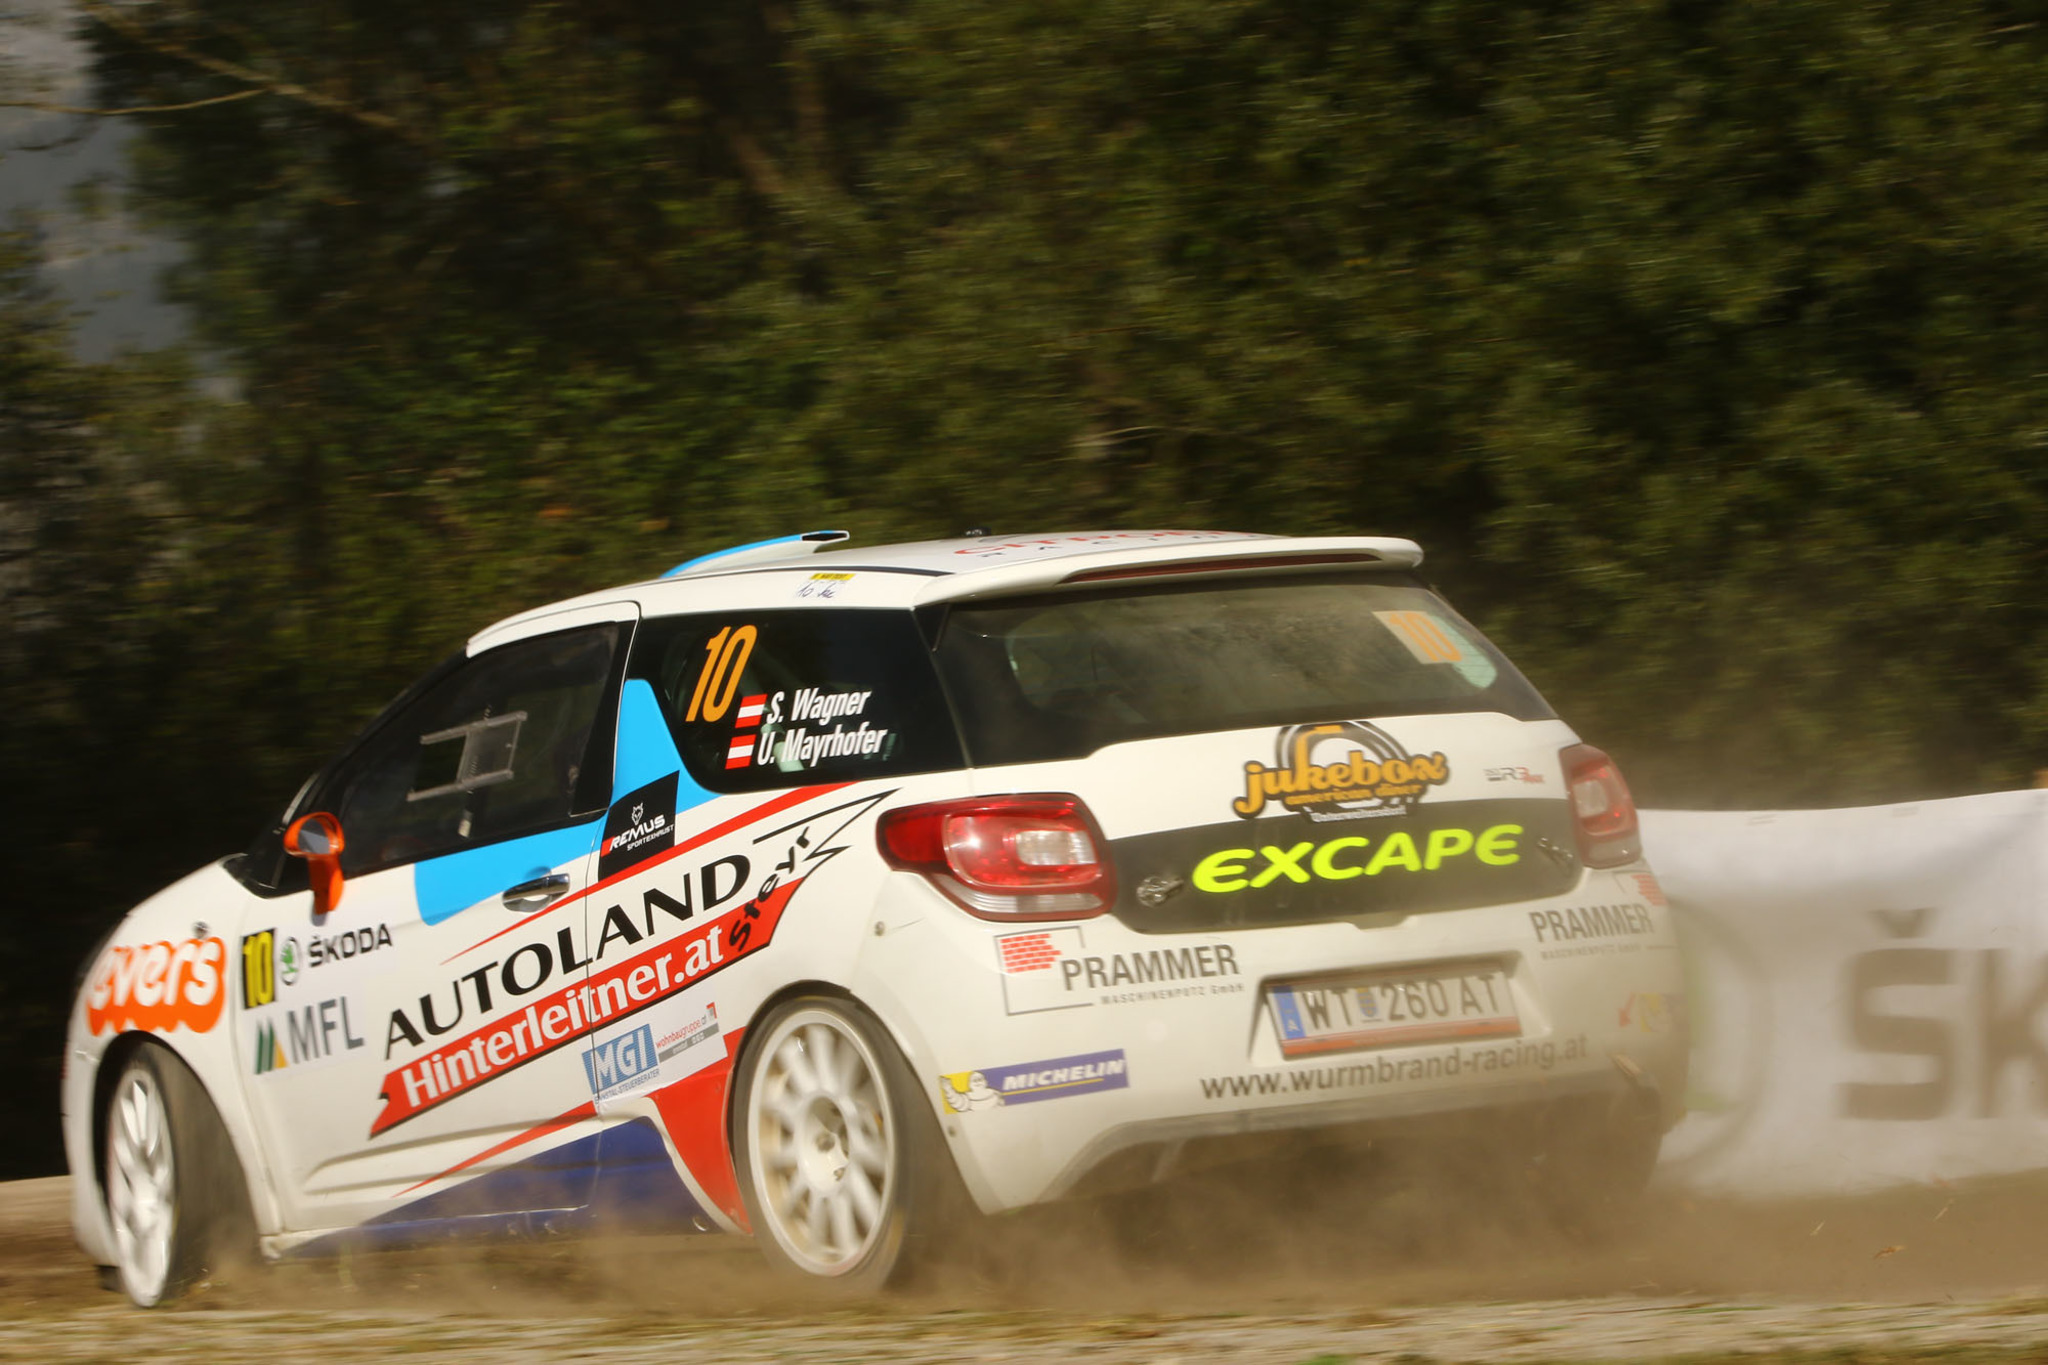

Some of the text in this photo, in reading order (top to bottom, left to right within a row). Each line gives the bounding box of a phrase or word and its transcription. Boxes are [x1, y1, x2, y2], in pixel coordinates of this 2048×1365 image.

[1389, 612, 1462, 662] 10
[685, 624, 758, 722] 10
[767, 687, 873, 727] S. Wagner
[757, 723, 887, 768] U. Mayrhofer
[1233, 724, 1449, 818] jukebox
[610, 814, 666, 852] REMUS
[626, 823, 675, 852] SPORTEXHAUST
[1192, 824, 1524, 893] EXCAPE
[308, 923, 393, 968] ŠKODA
[1528, 903, 1654, 943] PRAMMER
[242, 931, 274, 1008] 10
[384, 853, 752, 1061] AUTOLAND
[1061, 944, 1240, 991] PRAMMER
[288, 996, 364, 1064] MFL
[401, 925, 724, 1108] Hinterleitner.at
[1303, 974, 1500, 1030] WT 260 AT
[590, 1029, 648, 1091] MGI
[1002, 1059, 1125, 1091] MICHELIN
[1199, 1033, 1587, 1099] www.wurmbrand-racing.at
